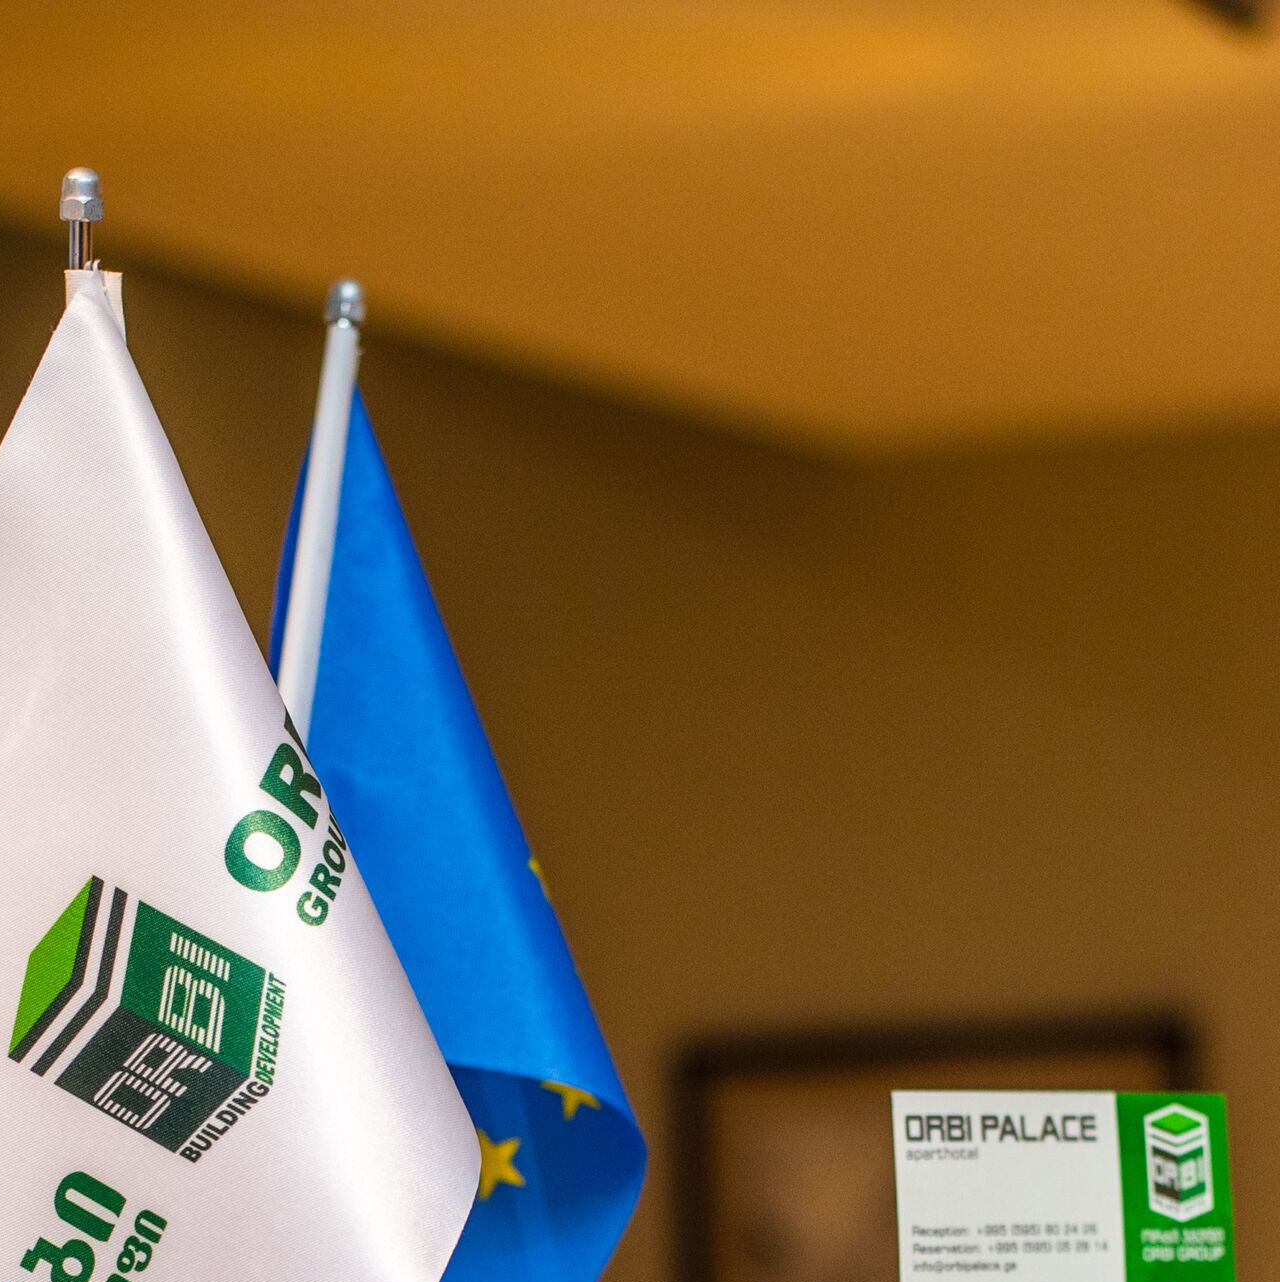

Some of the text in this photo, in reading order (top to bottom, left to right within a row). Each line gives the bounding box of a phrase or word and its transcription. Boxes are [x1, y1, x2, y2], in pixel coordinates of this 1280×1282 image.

[224, 707, 322, 892] OR
[296, 804, 347, 927] GROU
[94, 932, 231, 1130] ORBI
[179, 971, 287, 1164] BUILDING DEVELOPMENT
[904, 1114, 1097, 1142] ORBI PALACE
[906, 1147, 979, 1162] aparthotel
